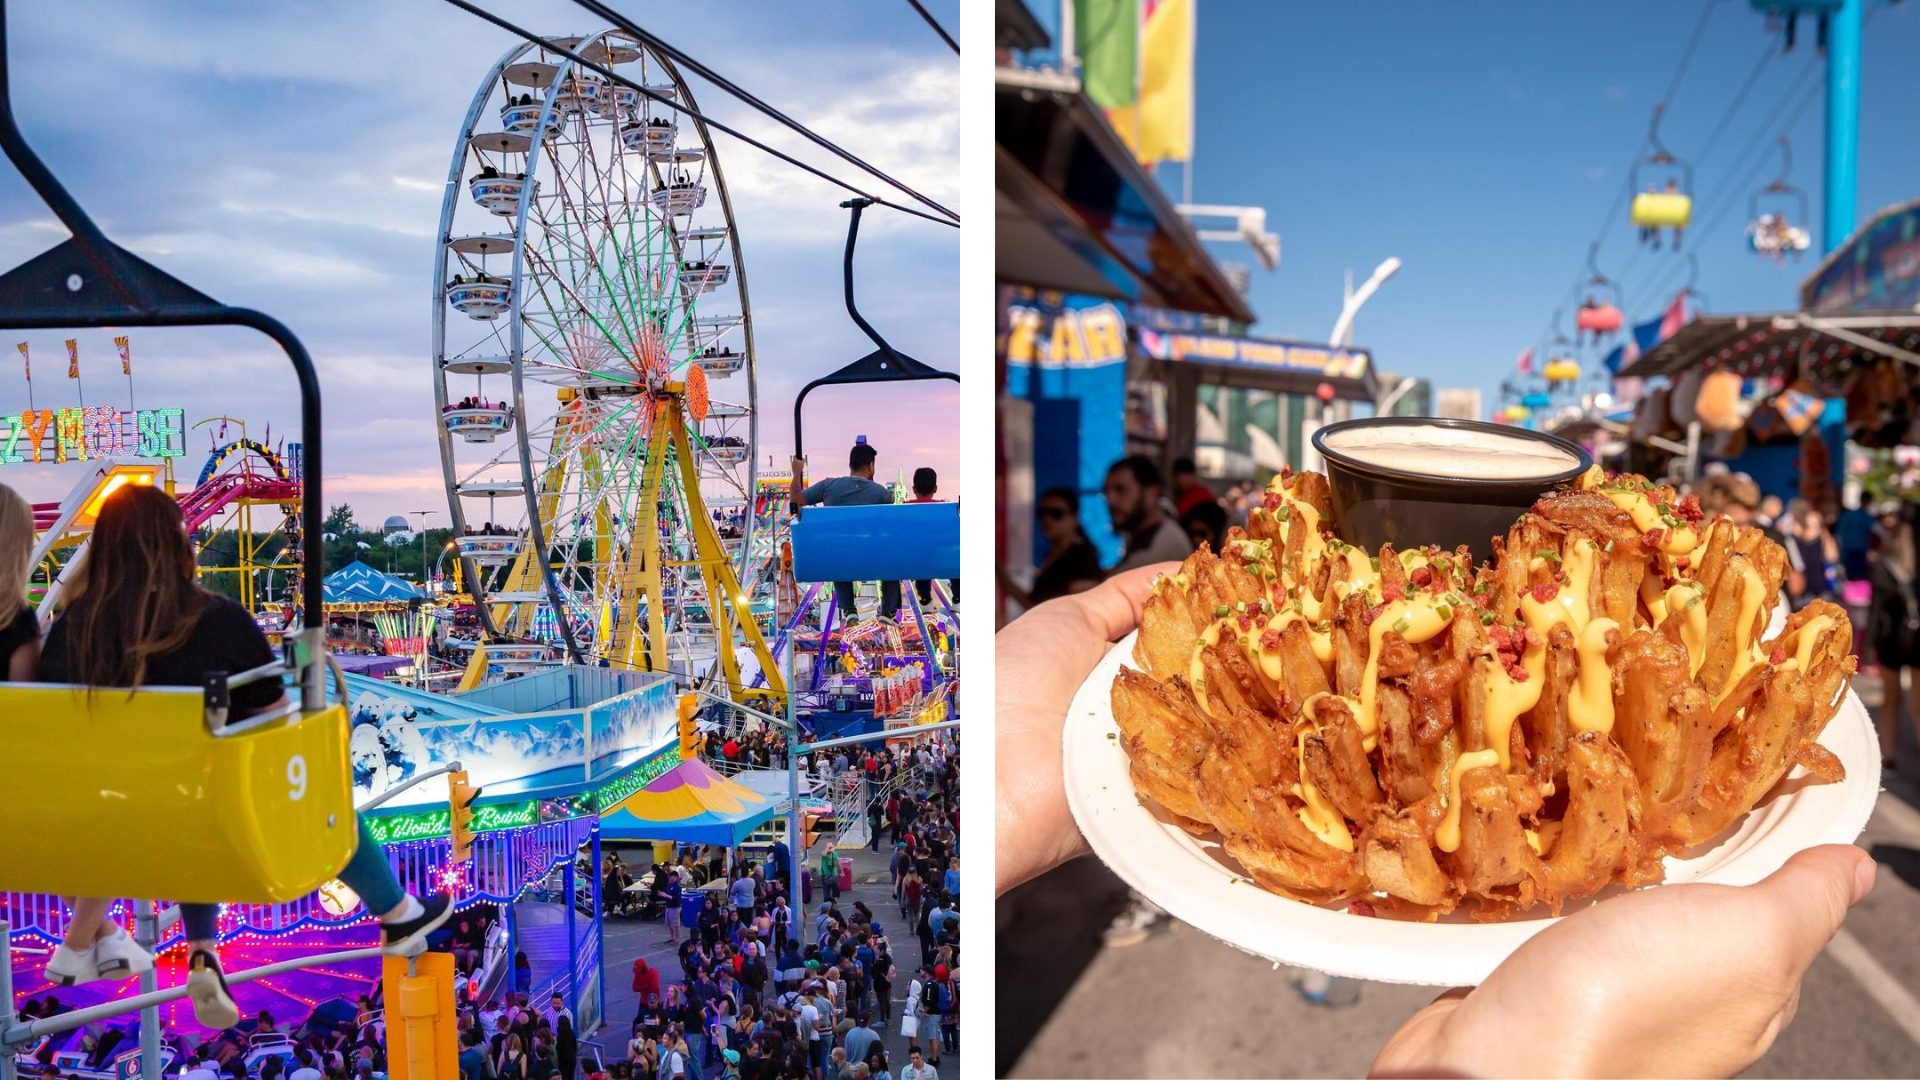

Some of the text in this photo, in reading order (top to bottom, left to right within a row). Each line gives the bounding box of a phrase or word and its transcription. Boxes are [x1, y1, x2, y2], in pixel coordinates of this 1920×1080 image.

[0, 405, 184, 464] ZY MOUSE
[287, 754, 307, 801] 9
